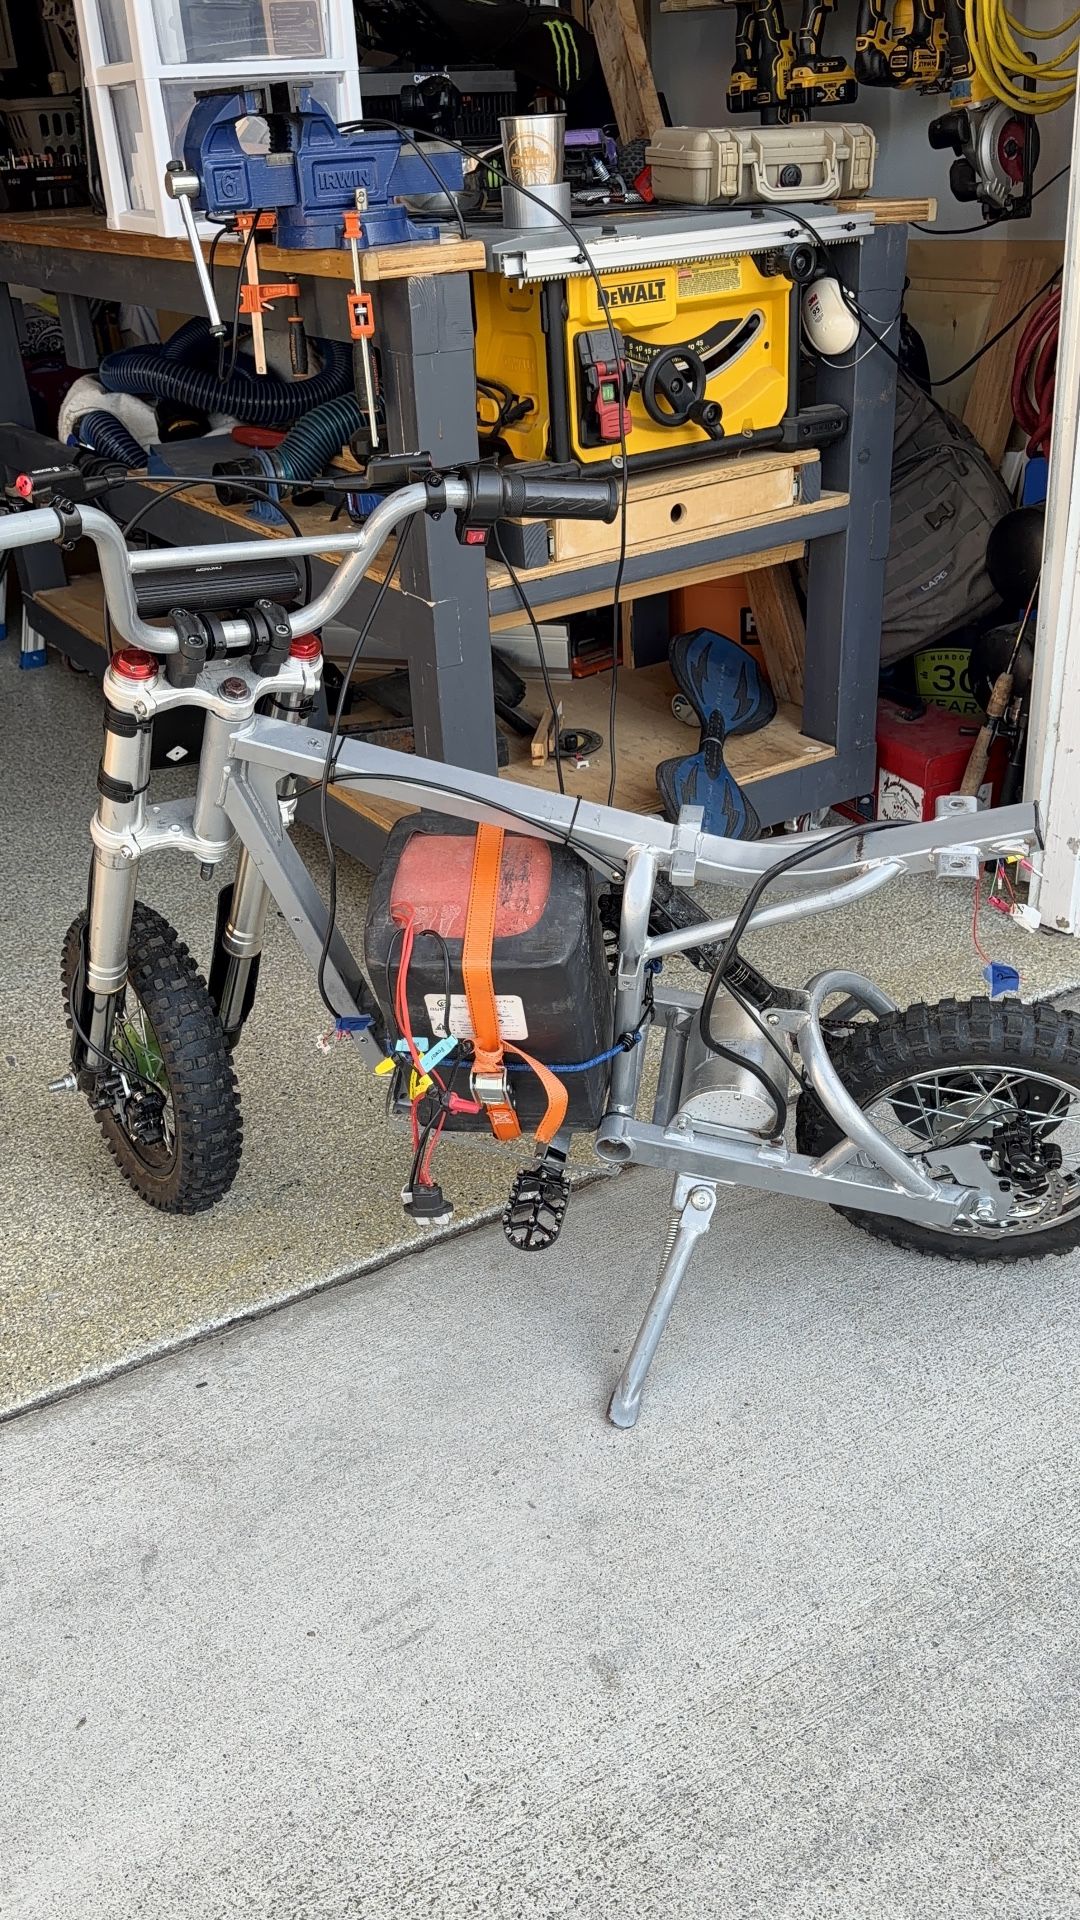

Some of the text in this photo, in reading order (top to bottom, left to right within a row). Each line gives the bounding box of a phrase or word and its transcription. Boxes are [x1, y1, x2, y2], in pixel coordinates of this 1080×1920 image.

[220, 170, 238, 198] 6
[317, 168, 371, 190] IRWIN
[920, 570, 948, 591] LAPG
[921, 697, 982, 714] YEAR
